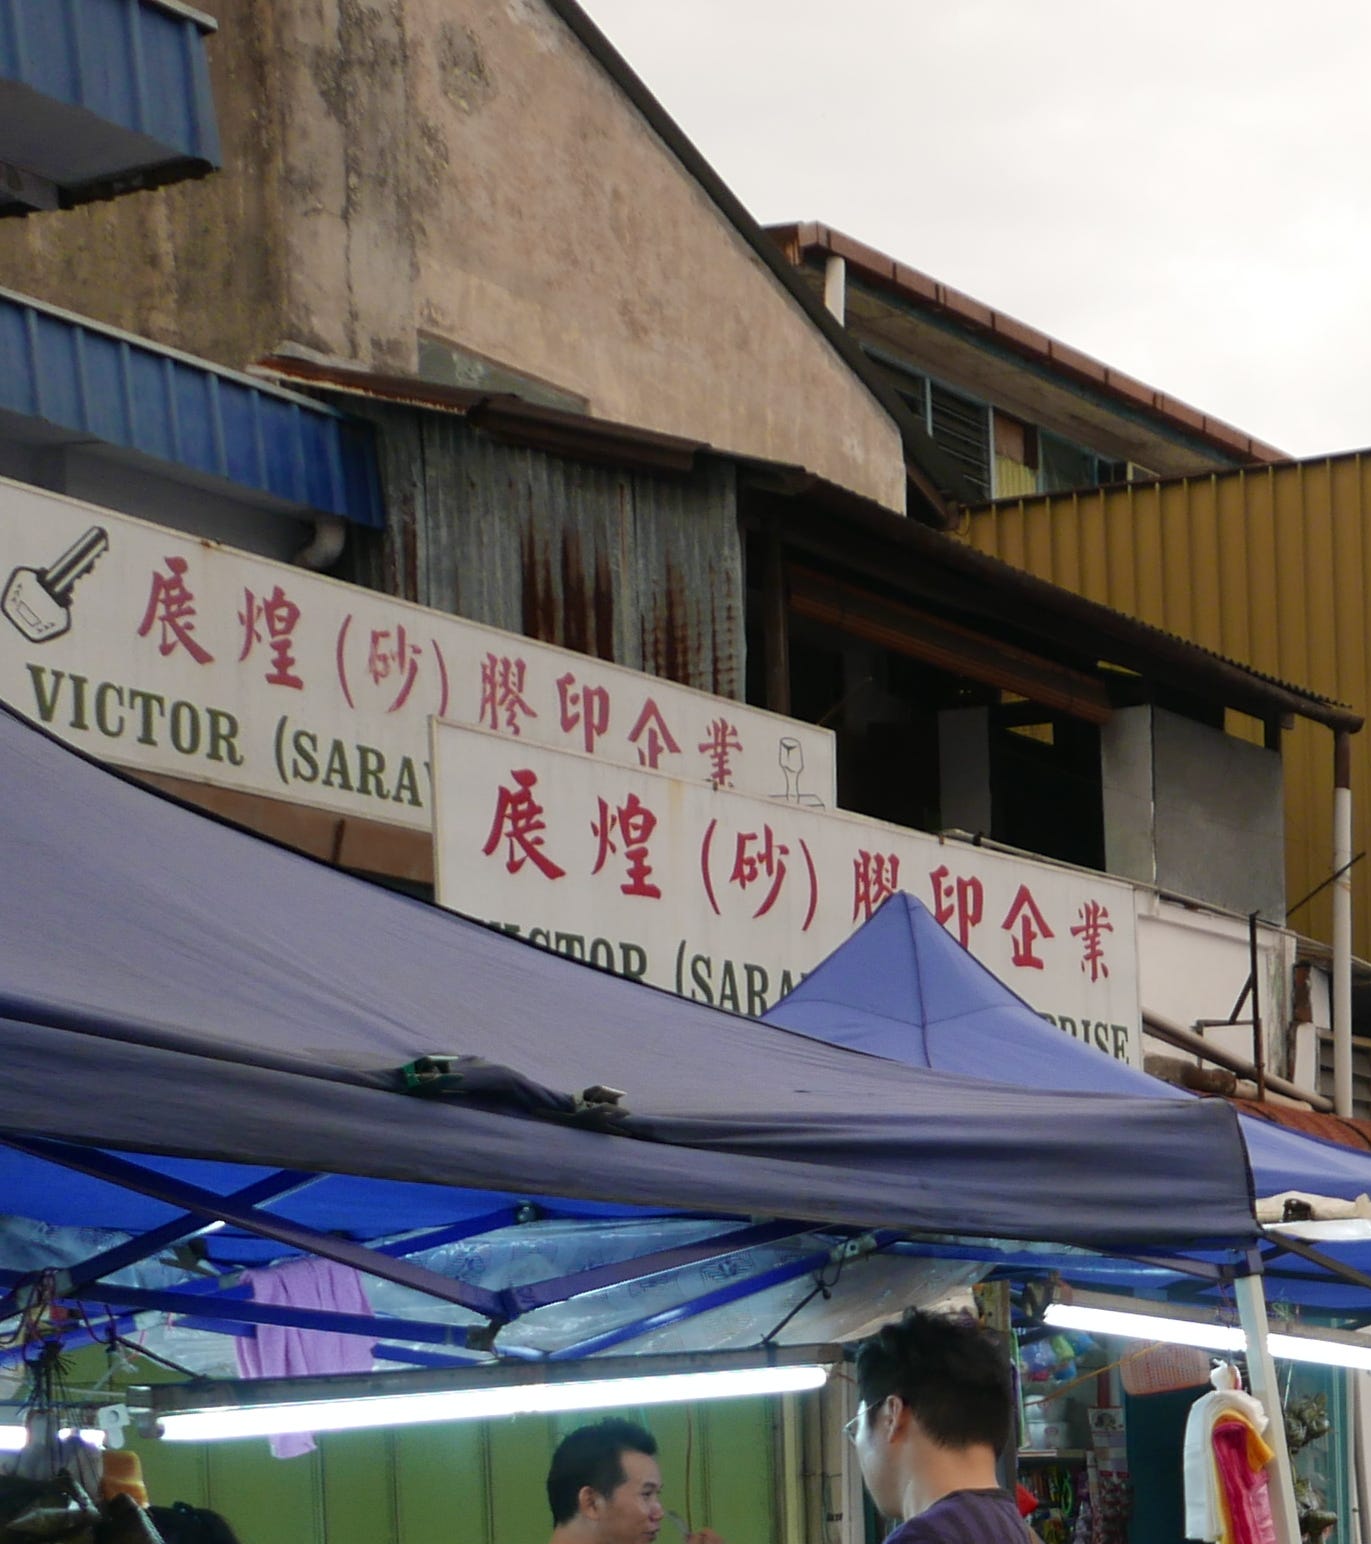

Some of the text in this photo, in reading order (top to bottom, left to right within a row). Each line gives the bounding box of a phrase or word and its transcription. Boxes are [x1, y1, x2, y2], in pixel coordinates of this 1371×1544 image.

[26, 663, 431, 807] VICTOR (SARA
[138, 556, 743, 788] 展煌(砂)膠印企業
[483, 769, 1113, 983] 展煌(砂)膠印企業
[675, 940, 808, 1018] (SARA
